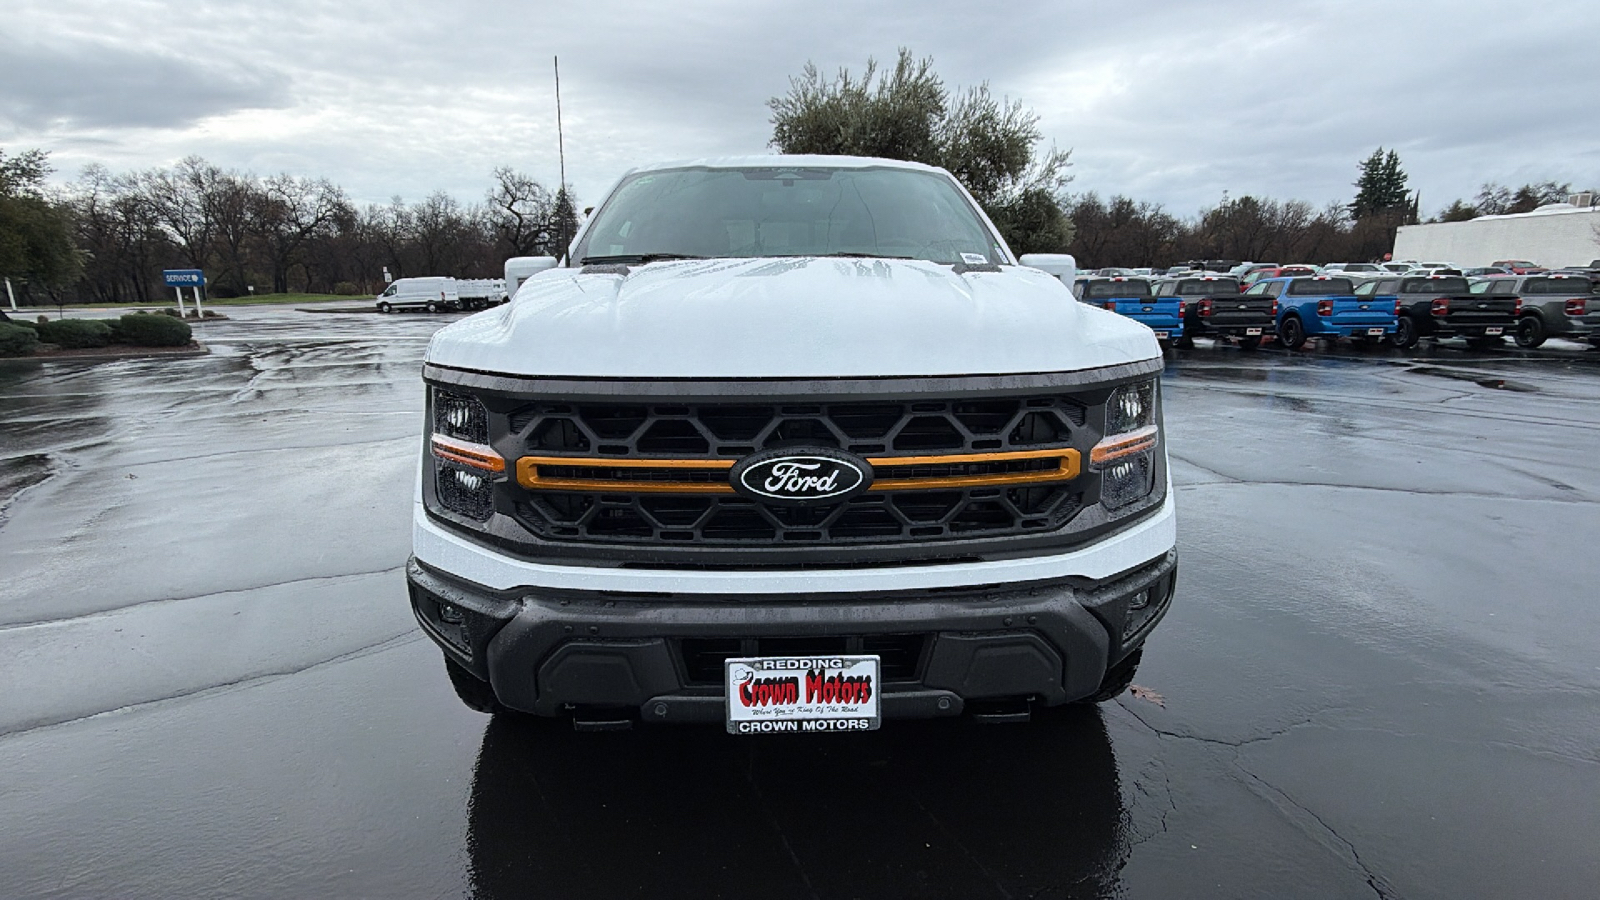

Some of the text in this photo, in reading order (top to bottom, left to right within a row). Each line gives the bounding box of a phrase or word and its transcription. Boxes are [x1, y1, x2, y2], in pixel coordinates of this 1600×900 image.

[166, 274, 191, 282] SERVICE
[764, 462, 839, 491] Ford
[763, 659, 843, 670] REDDING
[739, 669, 872, 707] Crown Motors
[815, 706, 824, 714] Of
[826, 705, 839, 713] The
[739, 719, 869, 732] CROWN MOTORS
